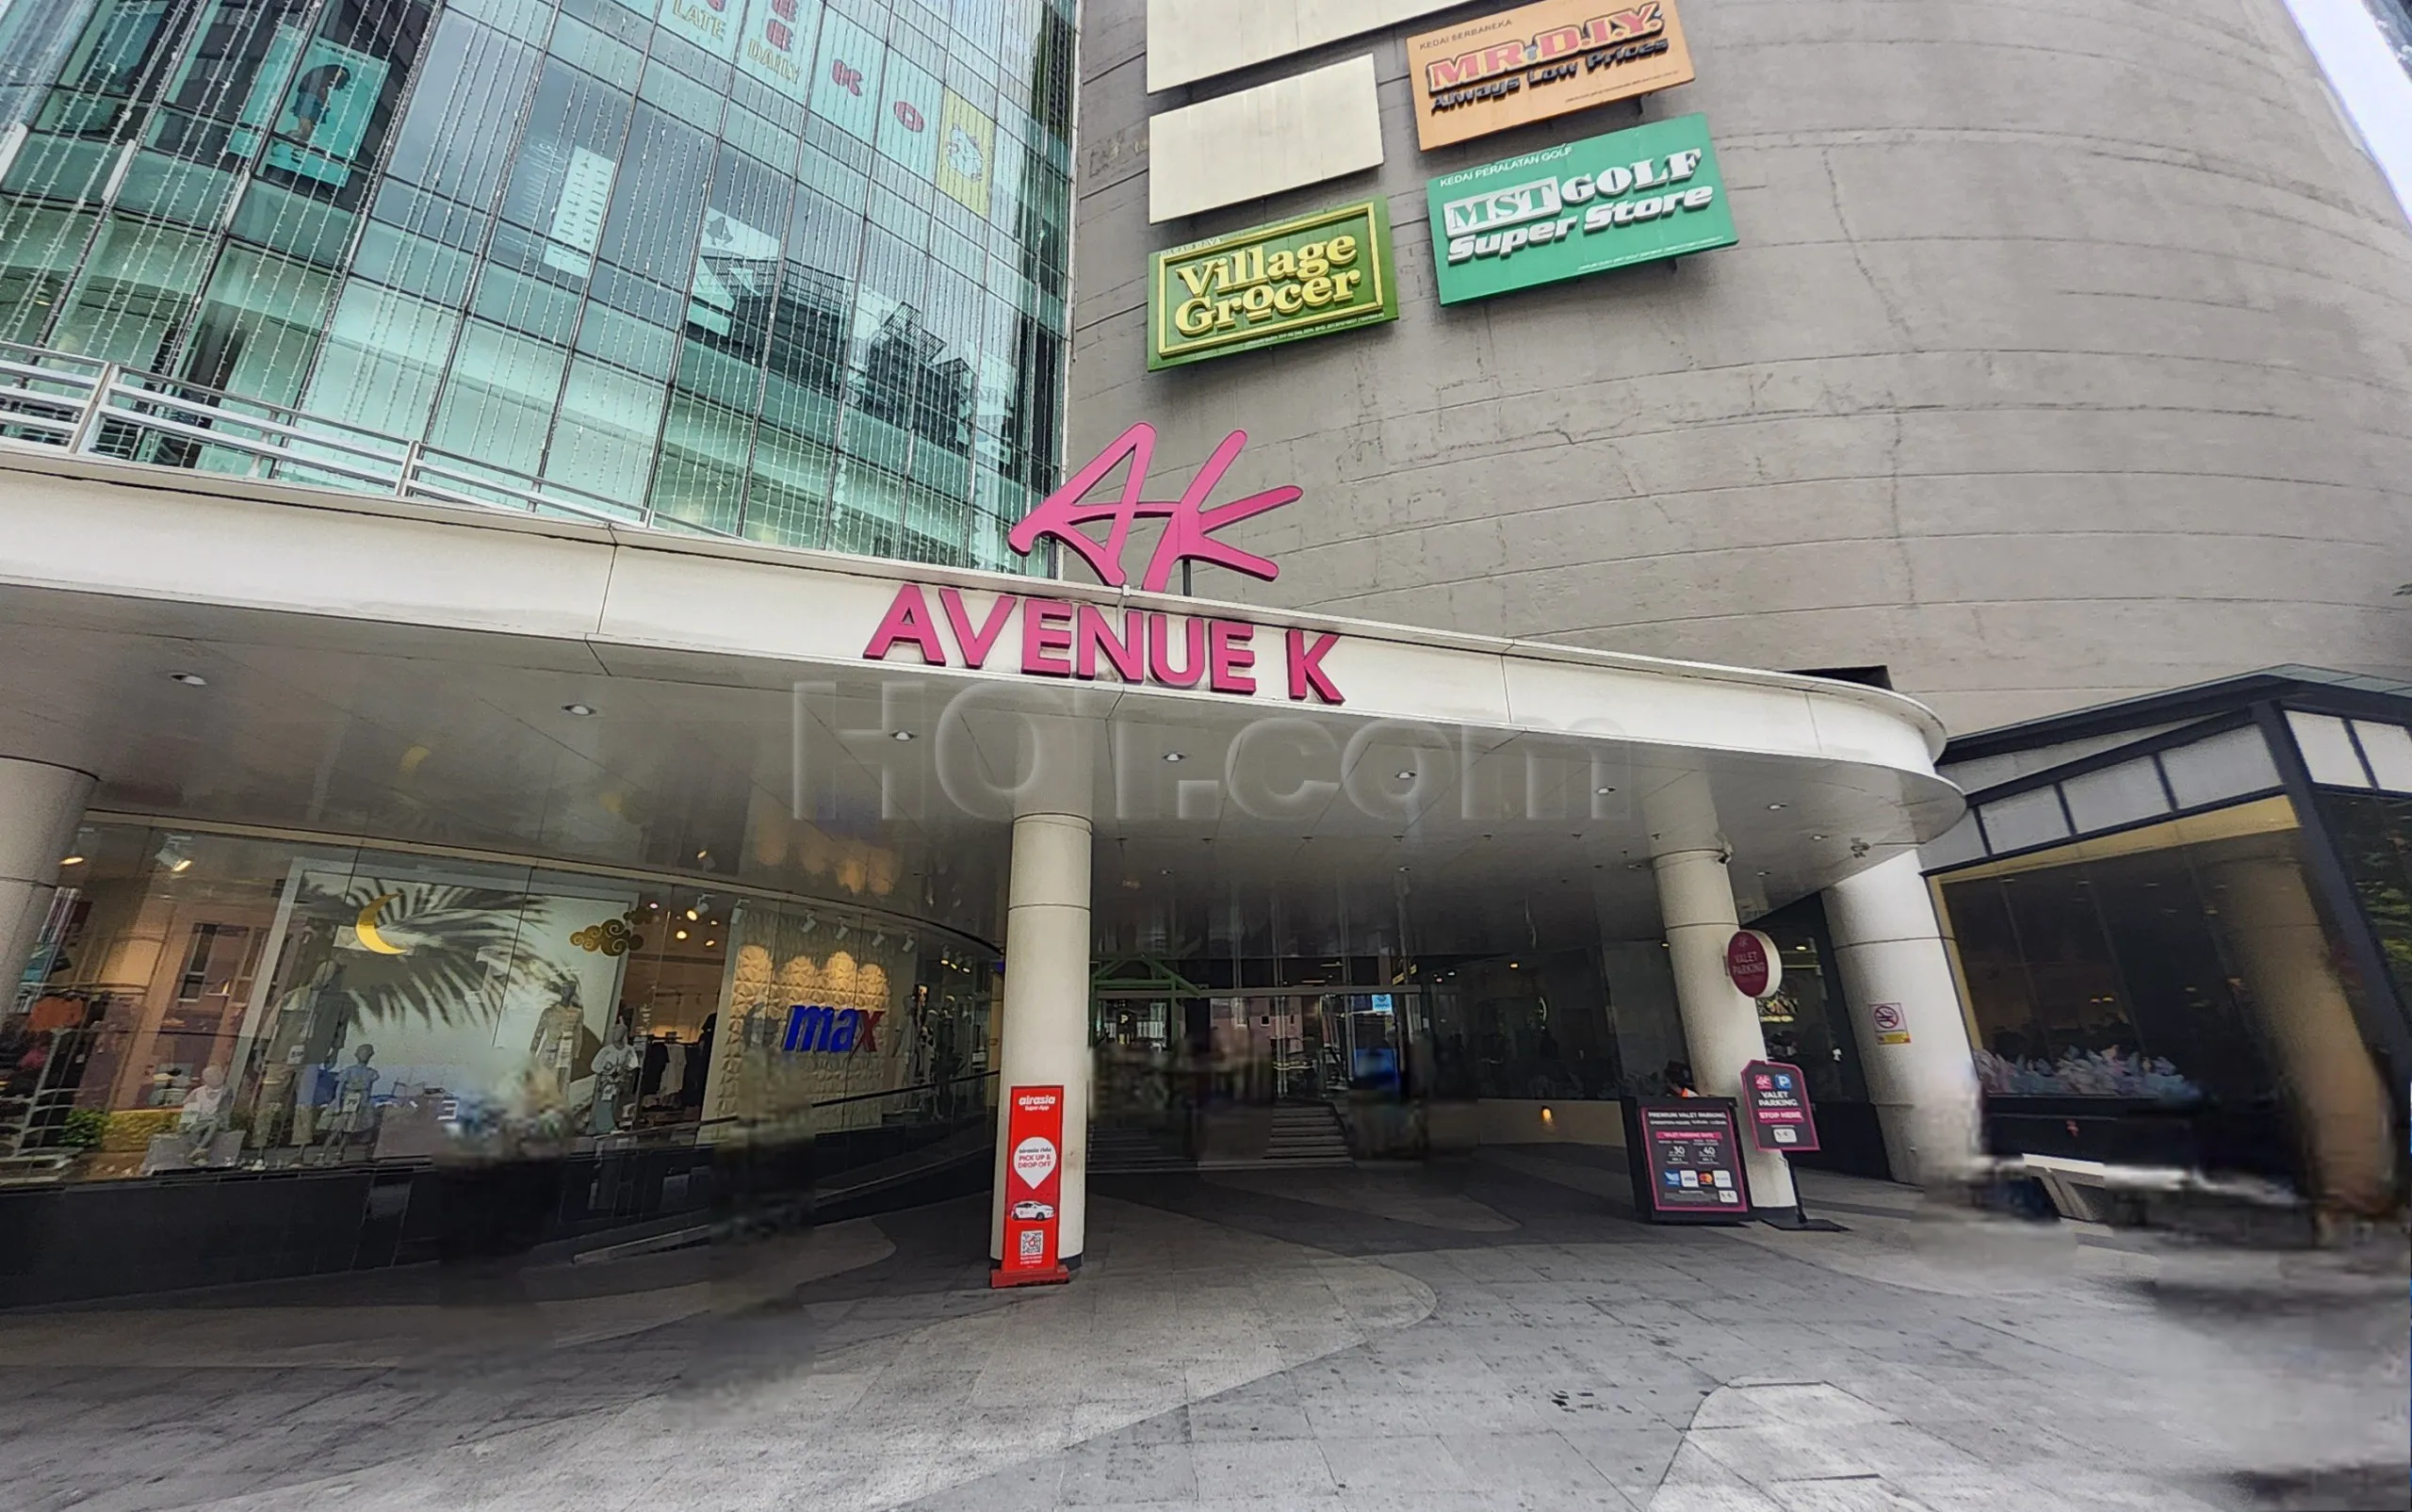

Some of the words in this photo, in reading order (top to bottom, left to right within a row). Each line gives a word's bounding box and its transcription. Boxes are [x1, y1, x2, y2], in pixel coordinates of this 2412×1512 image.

[1420, 36, 1449, 50] KEDAI
[1450, 19, 1512, 42] SERBANEKA
[1431, 75, 1521, 114] Always
[1527, 62, 1578, 86] Low
[1587, 38, 1669, 73] Prices
[1440, 171, 1473, 187] KEDAI
[1475, 154, 1540, 180] PERALATAN
[1541, 145, 1573, 162] GOLF
[1450, 183, 1554, 232] MST
[1560, 148, 1703, 204] GOLF
[1448, 215, 1578, 265] Super
[1584, 186, 1714, 233] Store
[1176, 236, 1358, 299] Village
[1175, 268, 1361, 336] Grocer
[862, 584, 1258, 695] AVENUE
[1286, 628, 1346, 705] K
[1732, 961, 1766, 975] PARKING
[1735, 951, 1757, 963] VALET
[781, 1004, 886, 1053] max
[1019, 1095, 1056, 1106] airasia
[1758, 1098, 1799, 1107] PARKING
